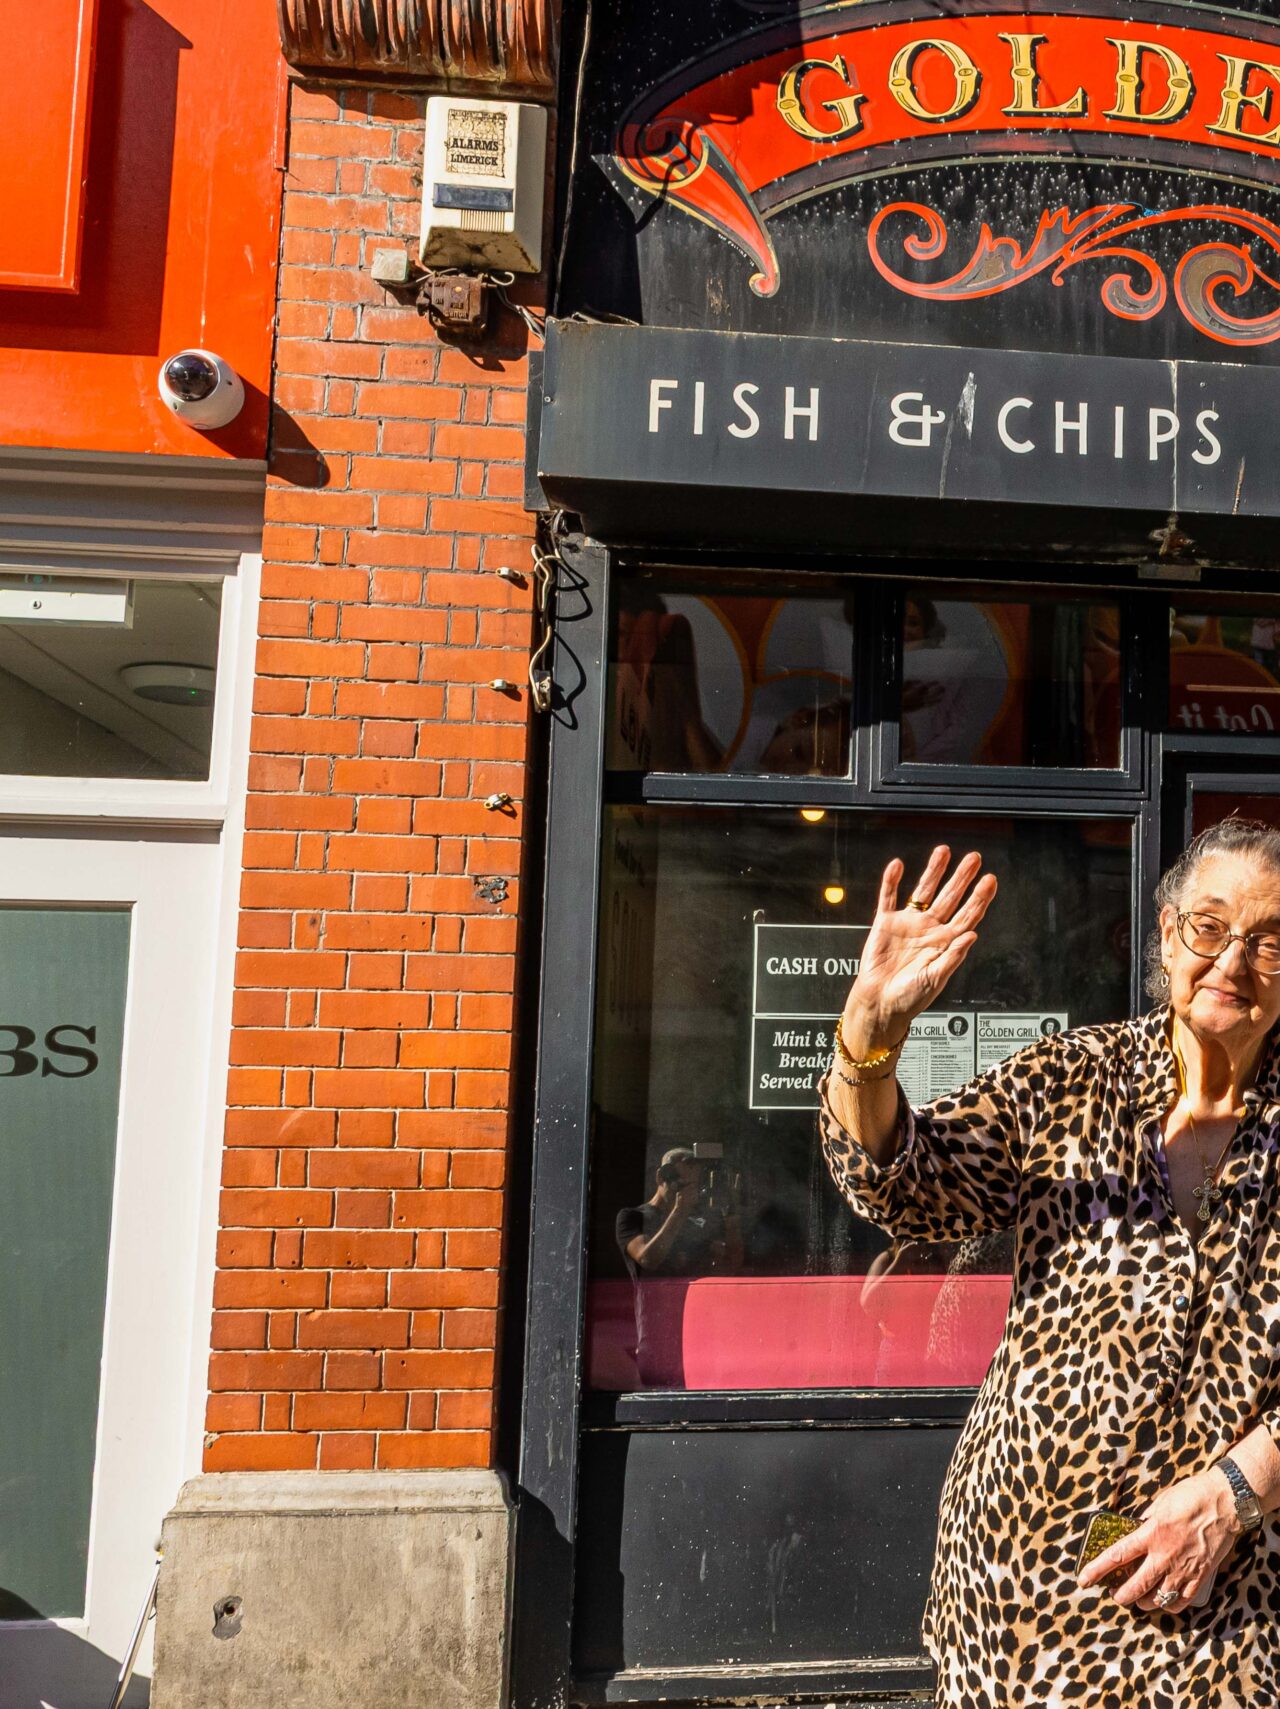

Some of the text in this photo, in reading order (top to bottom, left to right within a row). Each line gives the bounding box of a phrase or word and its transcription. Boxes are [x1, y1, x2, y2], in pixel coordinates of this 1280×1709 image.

[450, 137, 499, 151] ALARMS
[450, 154, 498, 166] LIMERICK
[647, 378, 820, 442] FISH
[888, 391, 946, 448] &
[998, 397, 1222, 466] CHIPS
[766, 957, 818, 975] CASH
[773, 1031, 811, 1048] Mini
[815, 1032, 828, 1048] &
[924, 1026, 947, 1036] GRILL
[979, 1027, 1039, 1038] GOLDEN GRILL
[779, 1053, 834, 1072] Breakf
[760, 1072, 812, 1089] Served
